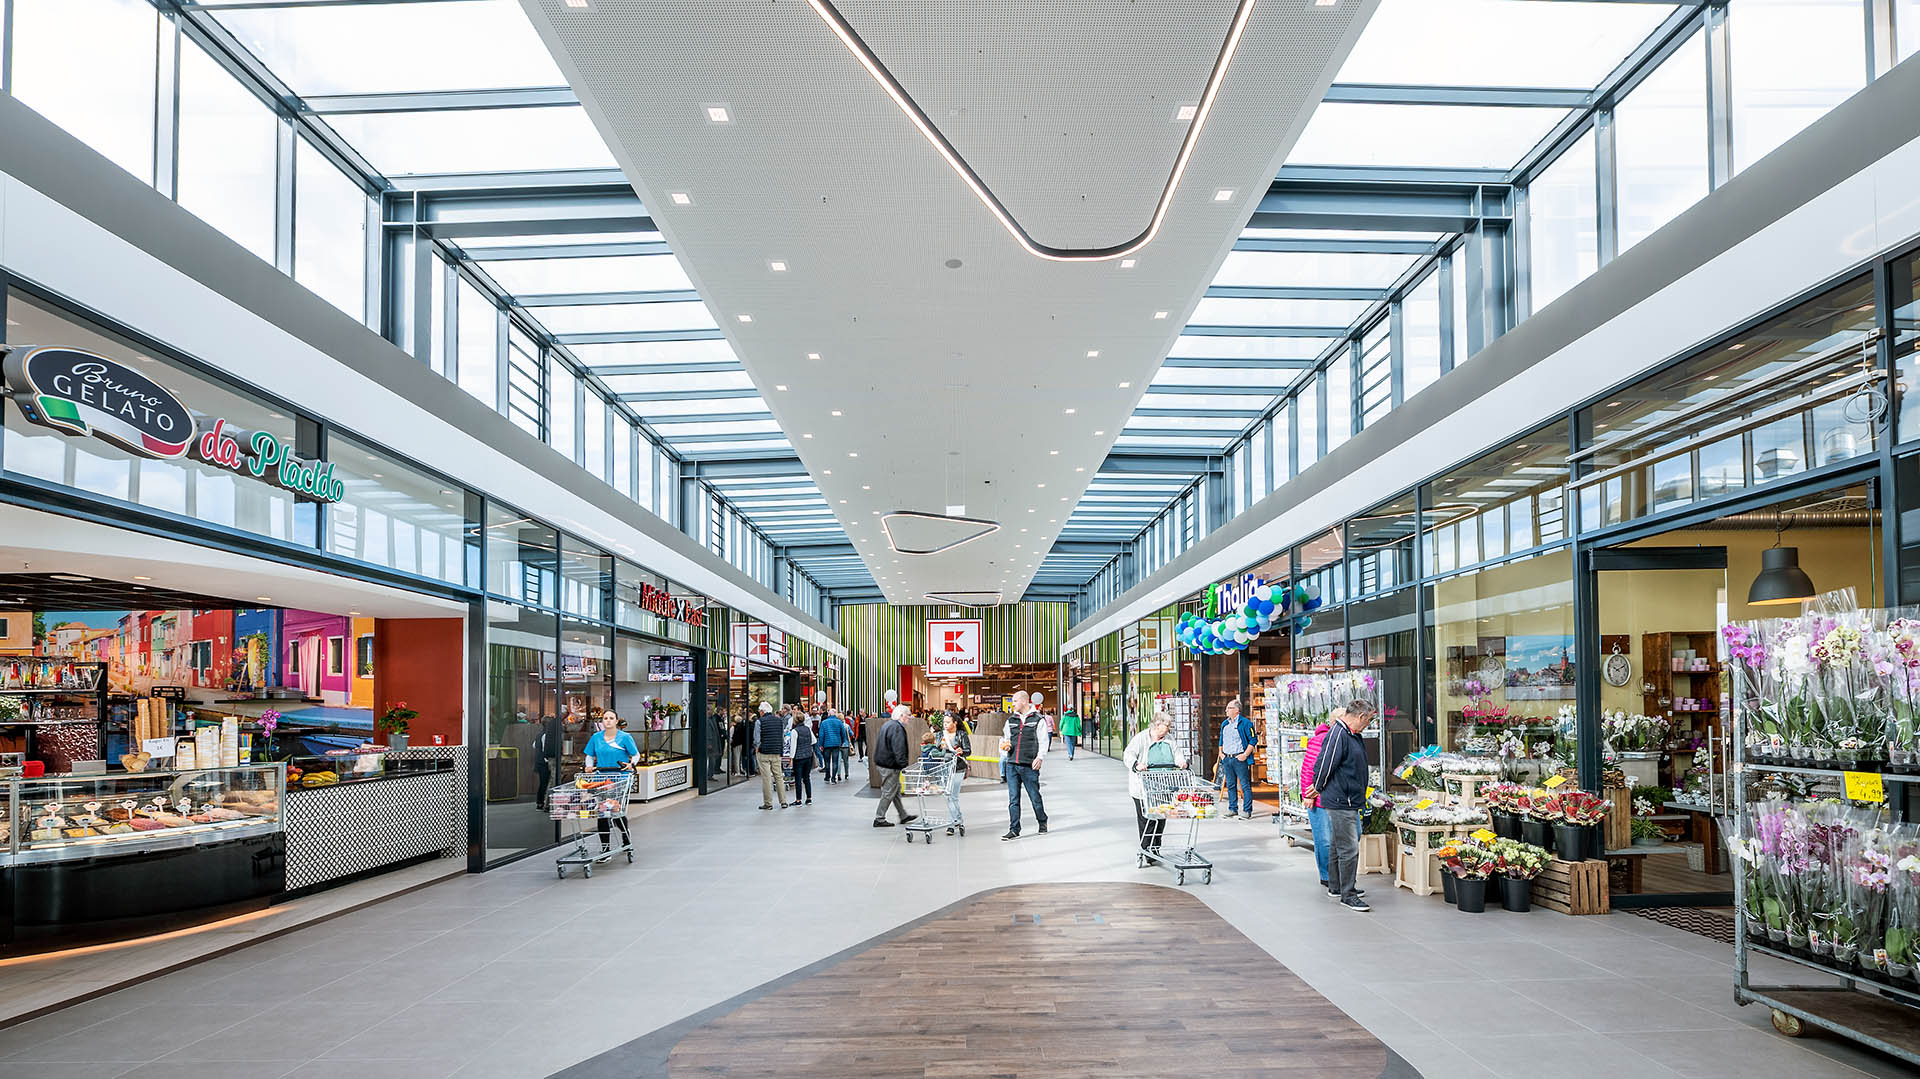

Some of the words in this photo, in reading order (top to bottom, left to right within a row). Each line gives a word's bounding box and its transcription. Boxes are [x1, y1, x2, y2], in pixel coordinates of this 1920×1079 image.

[53, 374, 174, 432] GELATO
[71, 362, 163, 407] Bruno
[200, 419, 239, 469] da
[249, 430, 344, 504] Placido
[640, 582, 676, 618] Middle
[685, 600, 702, 628] East
[934, 656, 975, 665] Kaufland
